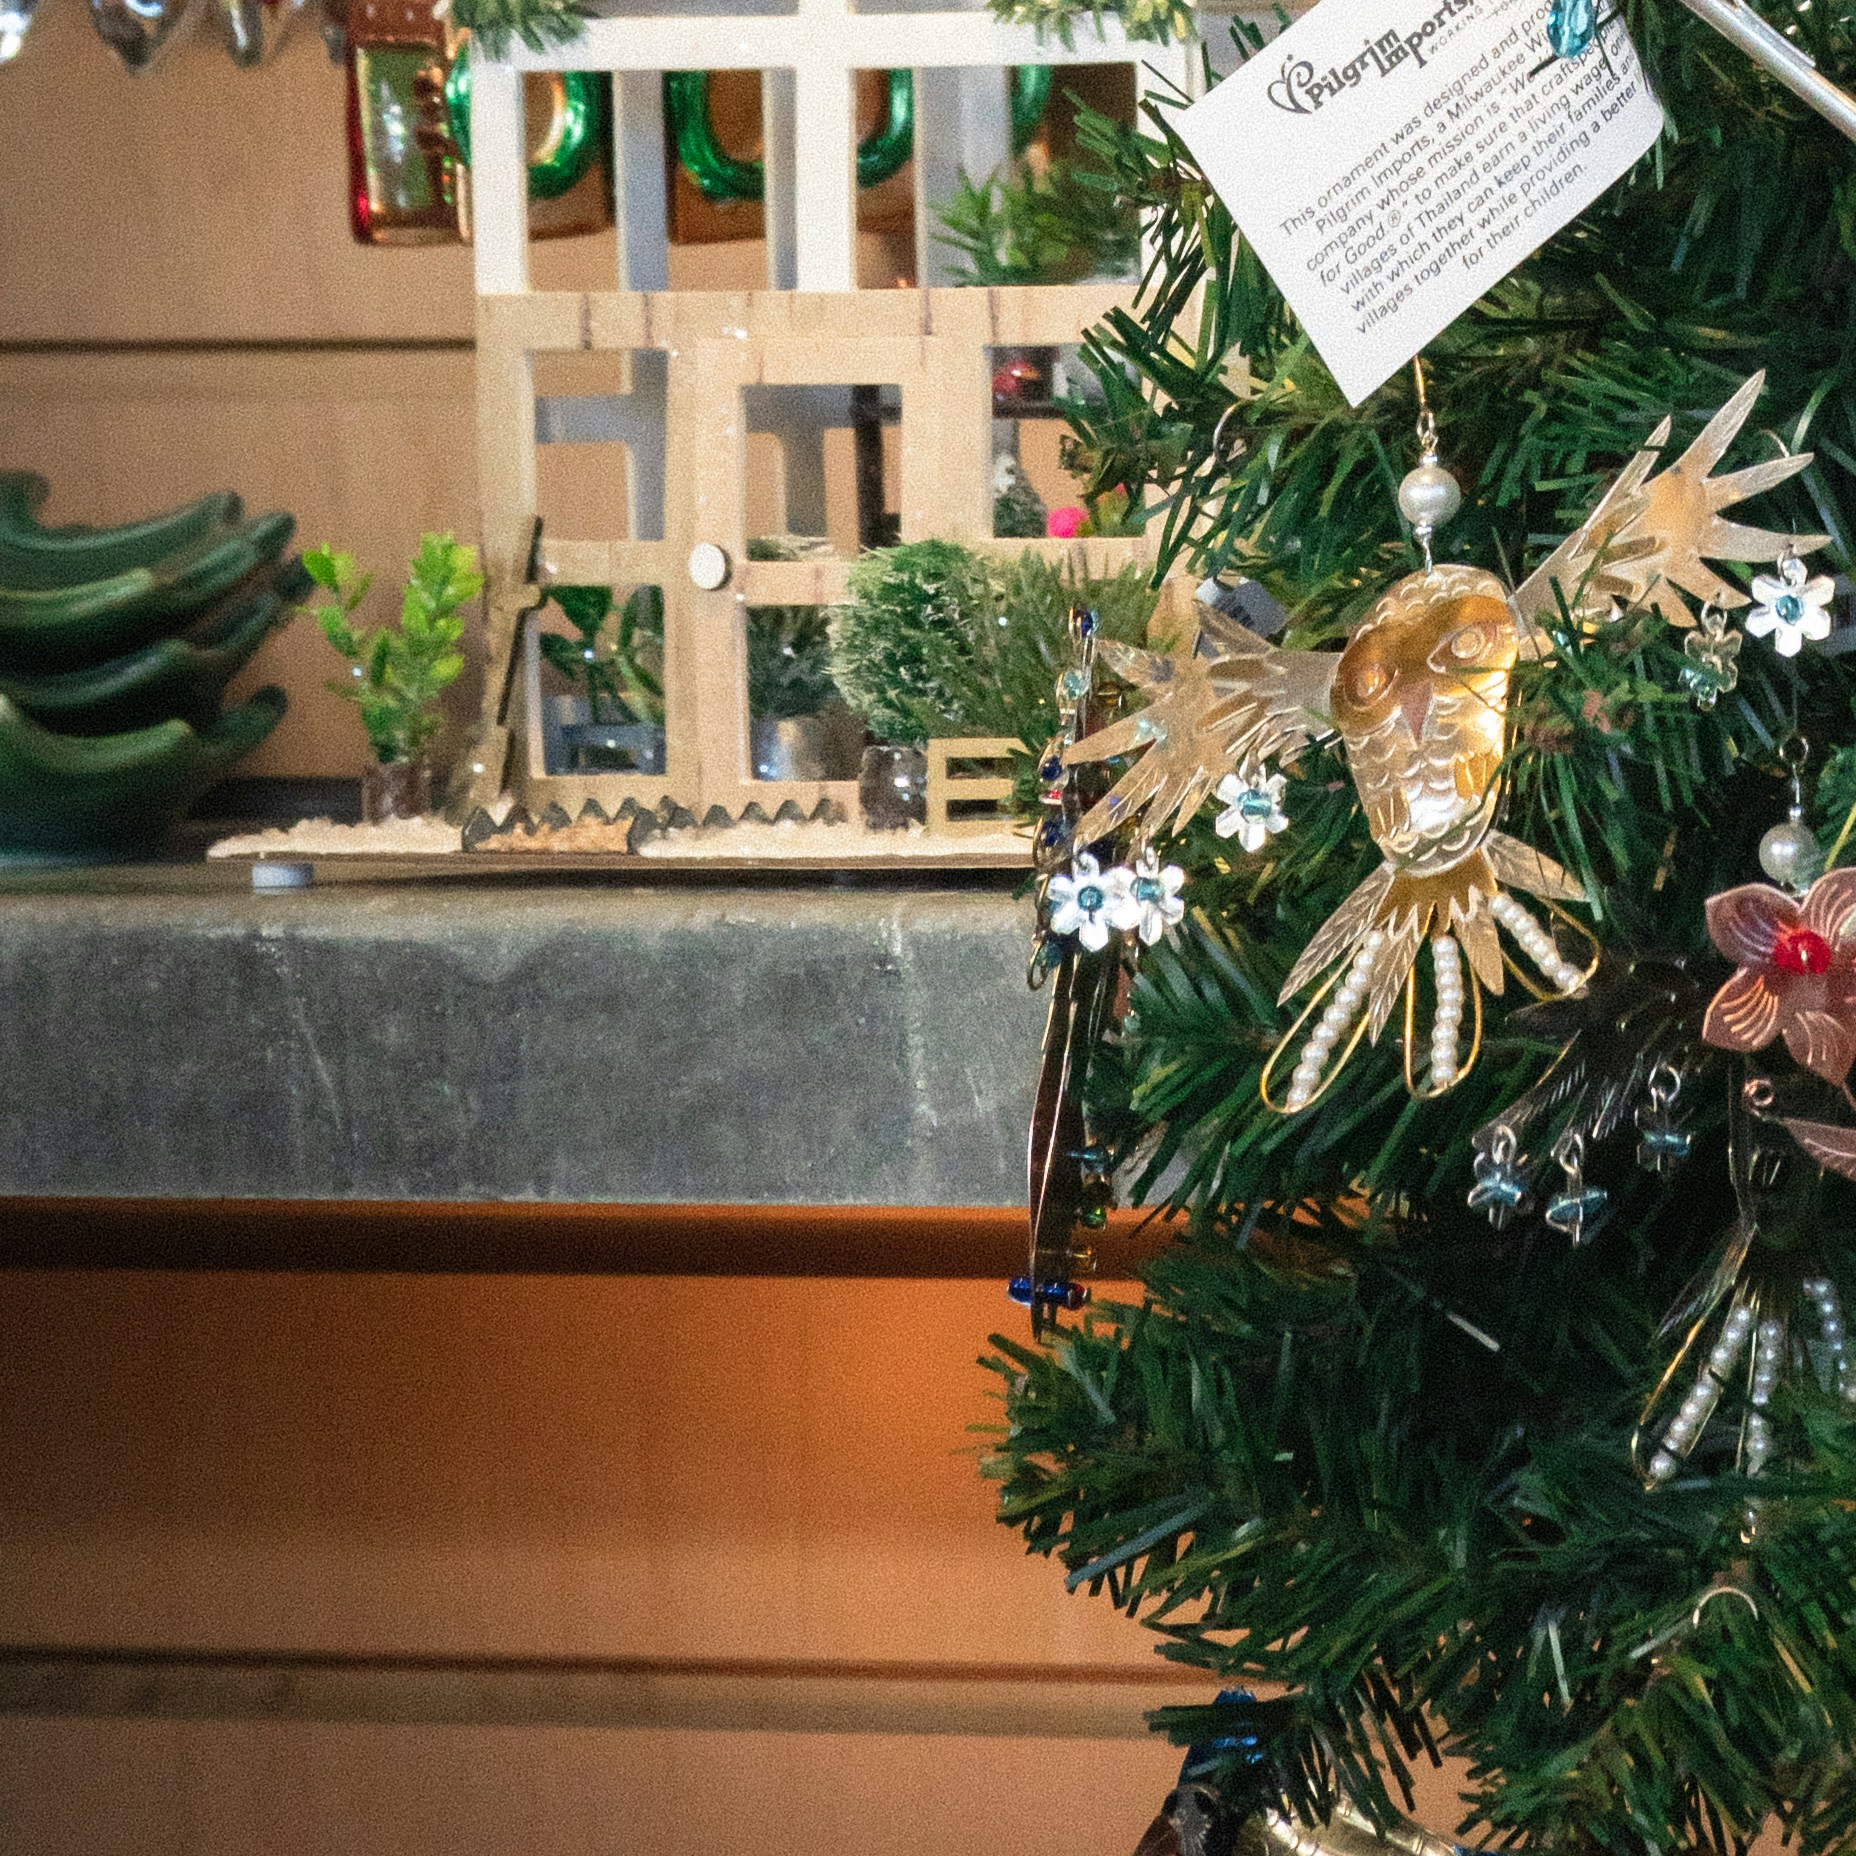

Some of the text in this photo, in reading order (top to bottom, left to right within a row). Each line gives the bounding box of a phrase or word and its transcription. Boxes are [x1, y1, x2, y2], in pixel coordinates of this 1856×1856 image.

[1279, 206, 1316, 236] This
[1317, 141, 1390, 209] ornament
[1390, 116, 1422, 146] was
[1423, 52, 1490, 119] designed
[1491, 26, 1520, 60] and
[1304, 28, 1405, 110] Pilgrim
[1314, 186, 1372, 235] Pilgrim
[1370, 135, 1436, 188] Imports,
[1436, 121, 1448, 134] a
[1445, 52, 1526, 122] Milwaukee
[1306, 101, 1501, 272] company whose mission is
[1319, 262, 1342, 287] for
[1413, 187, 1433, 206] to
[1433, 150, 1474, 190] make
[1474, 120, 1508, 154] sure
[1508, 92, 1540, 124] that
[1340, 243, 1398, 295] villages
[1398, 222, 1416, 246] of
[1414, 168, 1481, 228] Thailand
[1481, 141, 1516, 174] earn
[1517, 130, 1528, 144] a
[1527, 93, 1572, 134] living
[1351, 281, 1385, 312] with
[1386, 240, 1432, 283] which
[1431, 212, 1465, 244] they
[1466, 186, 1495, 214] can
[1493, 154, 1532, 189] keep
[1531, 122, 1566, 158] their
[1564, 68, 1622, 124] families
[1356, 81, 1637, 335] villages together while providing a better
[1461, 163, 1584, 270] for their children.
